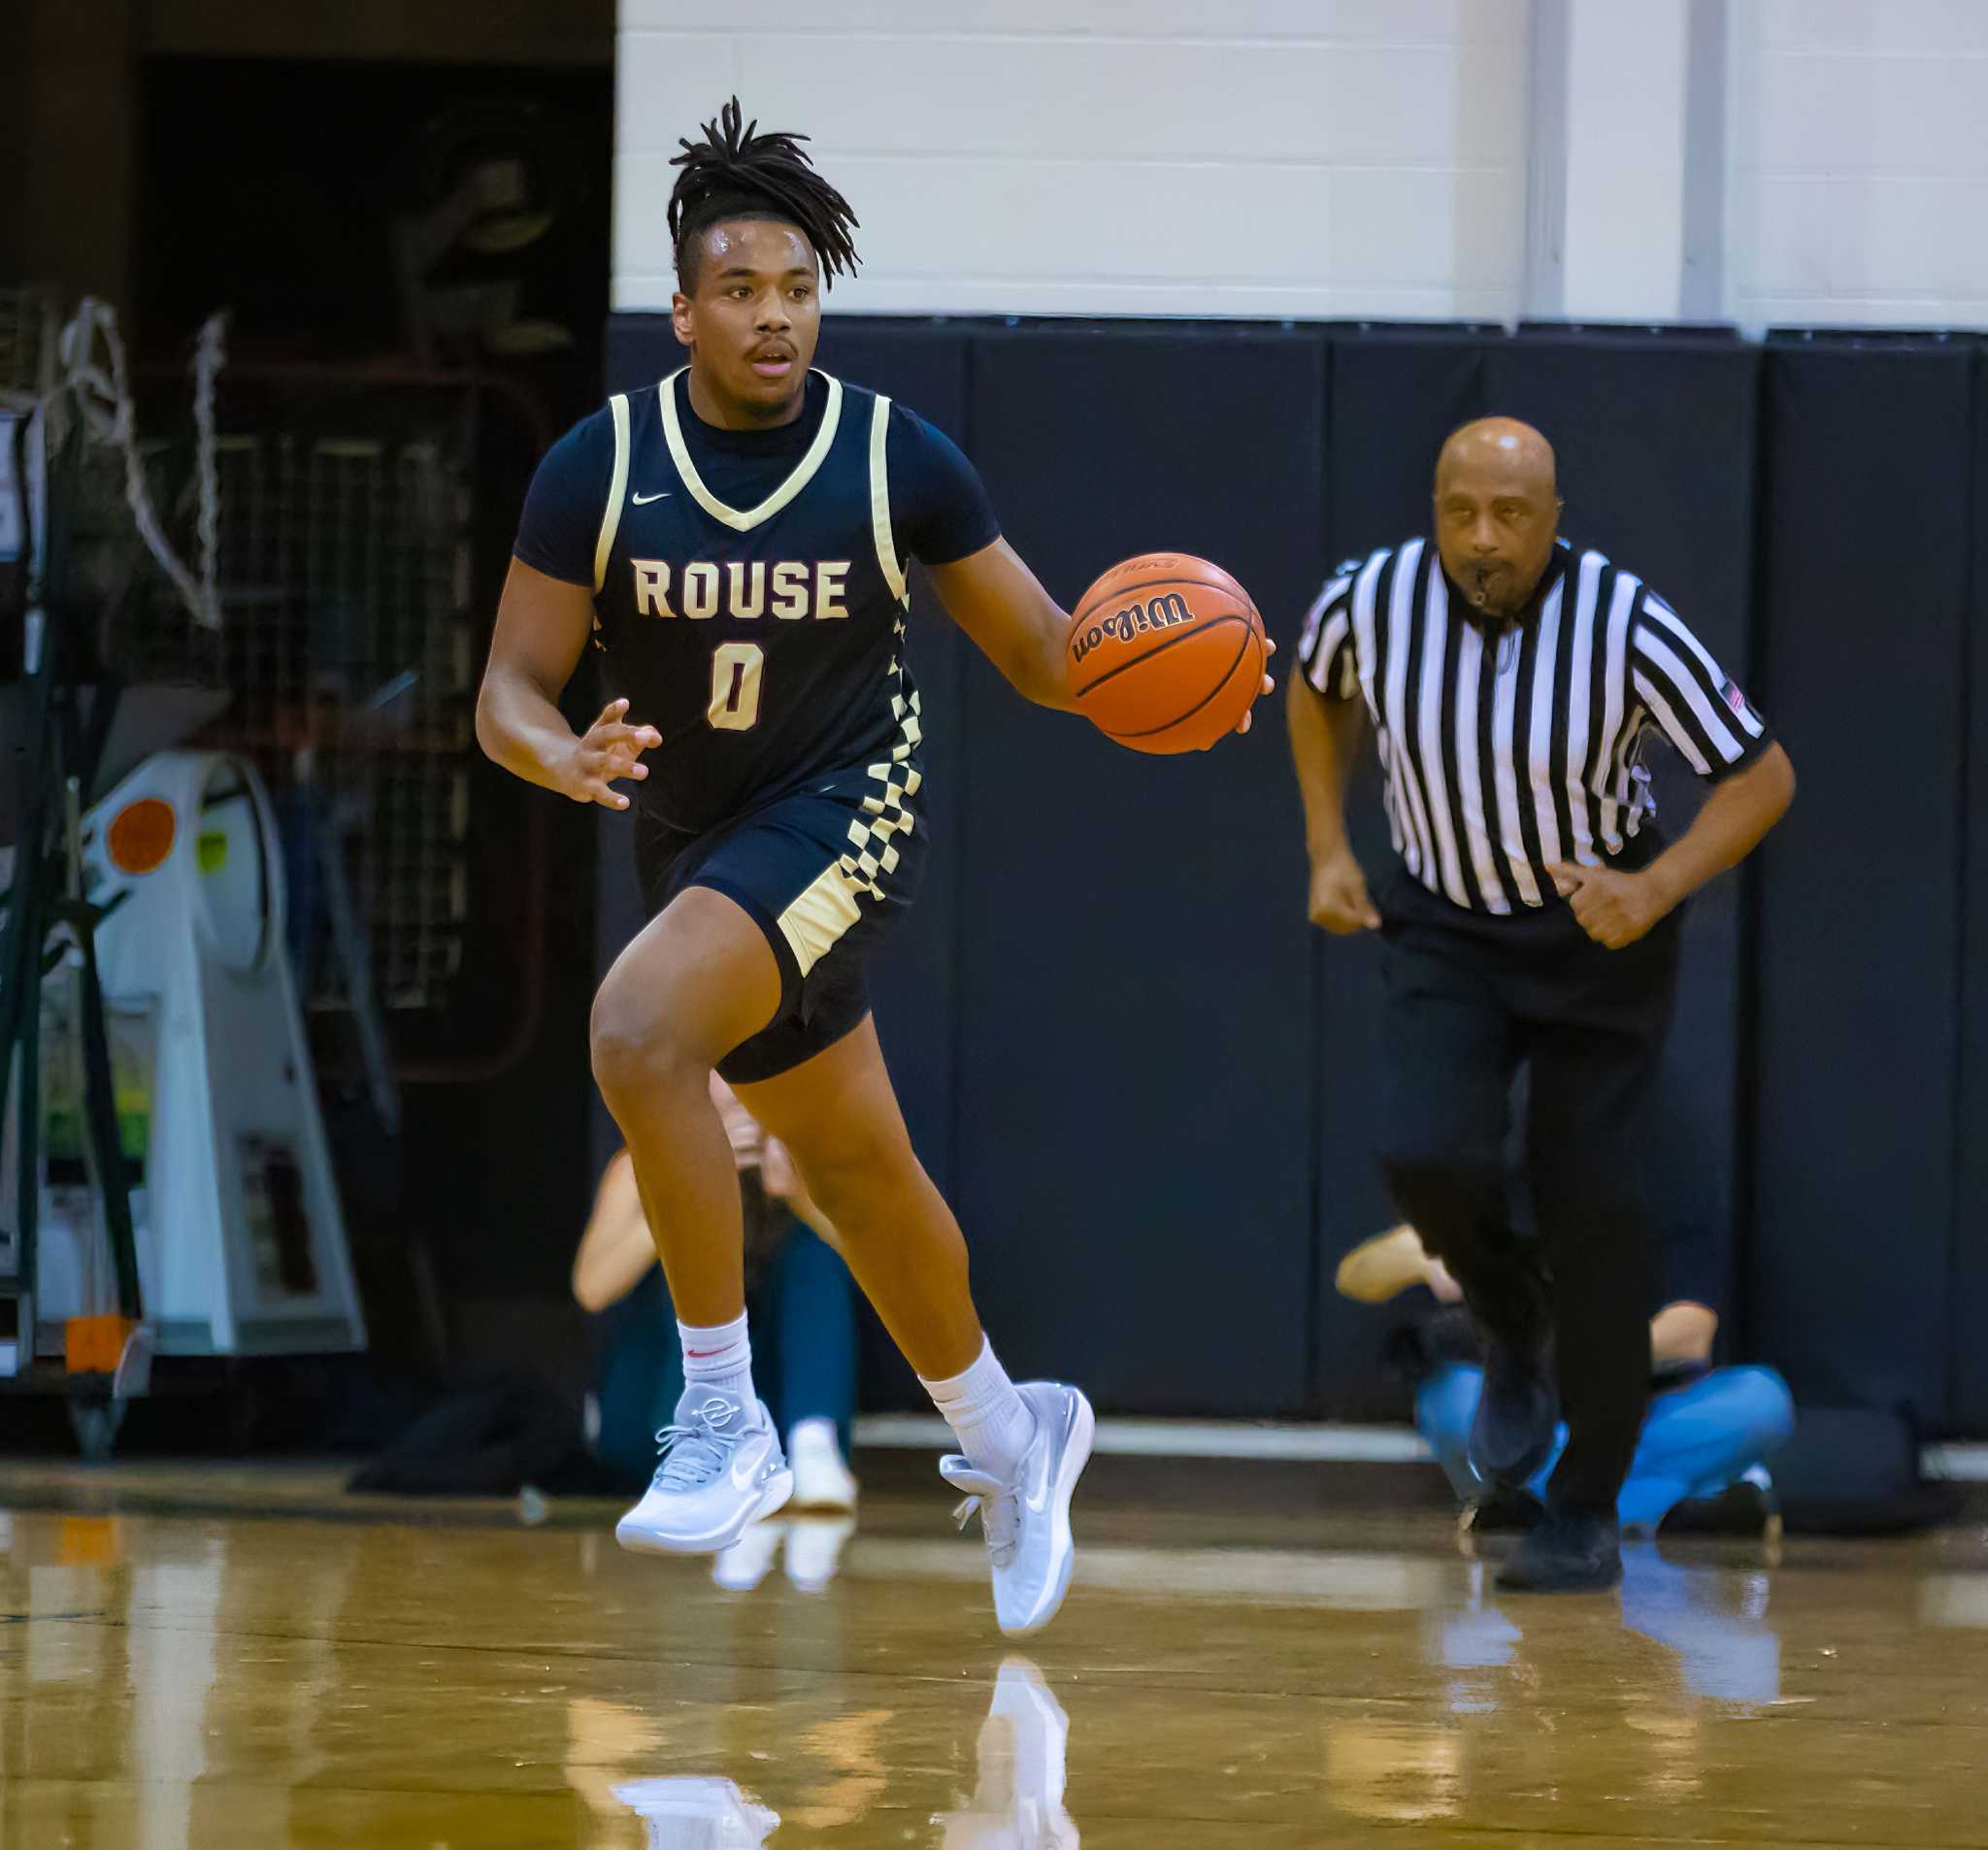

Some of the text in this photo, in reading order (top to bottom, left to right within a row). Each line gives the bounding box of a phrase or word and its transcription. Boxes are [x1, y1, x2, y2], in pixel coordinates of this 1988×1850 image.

[631, 559, 851, 619] ROUSE
[1072, 593, 1196, 663] Wilson
[708, 643, 764, 731] 0
